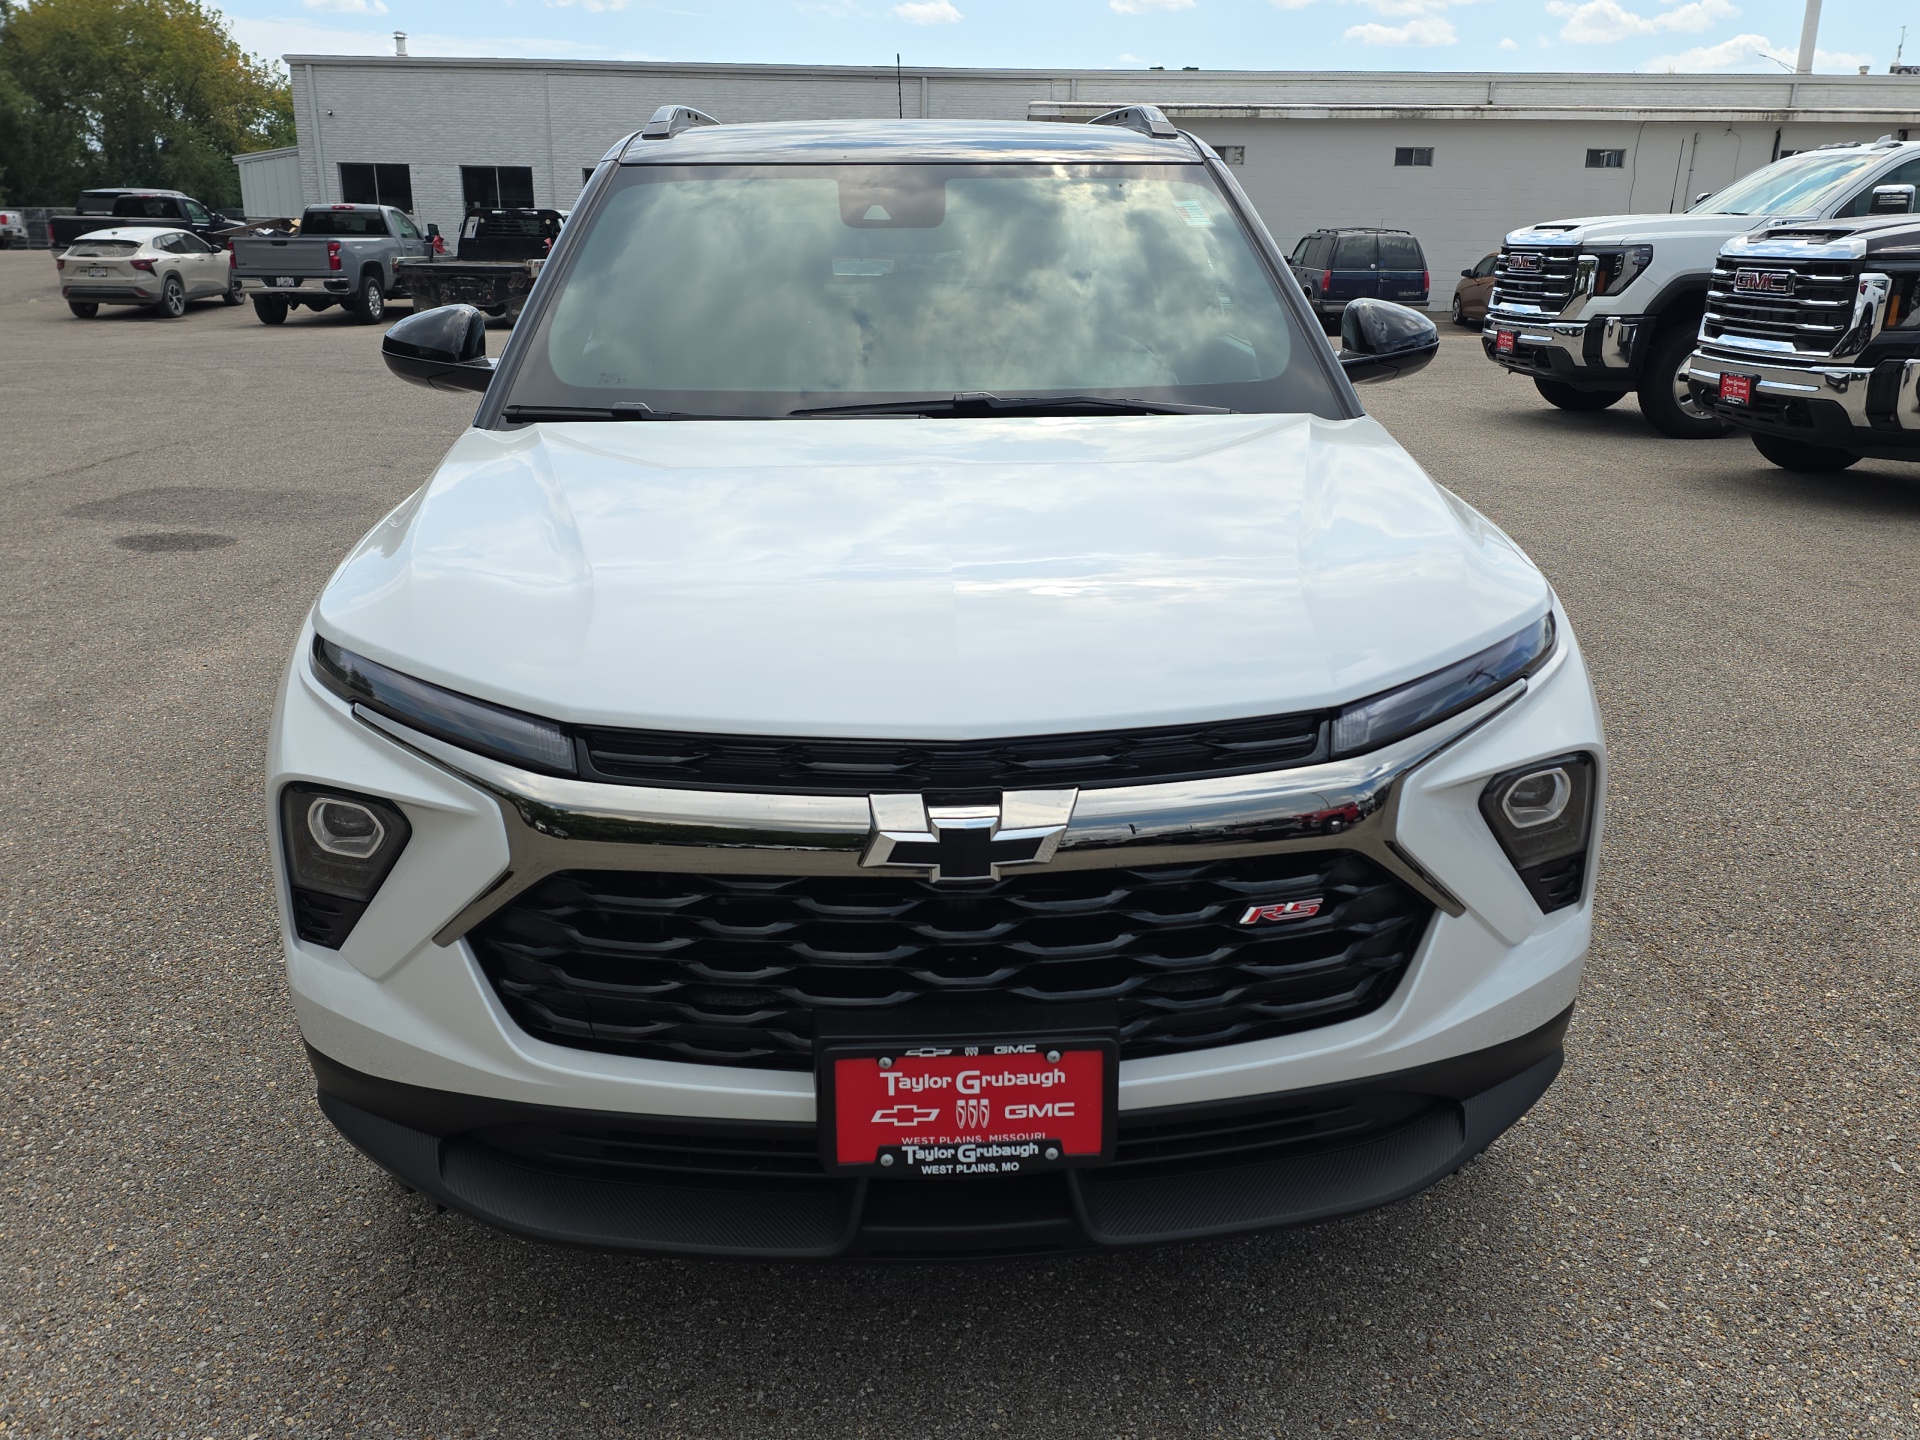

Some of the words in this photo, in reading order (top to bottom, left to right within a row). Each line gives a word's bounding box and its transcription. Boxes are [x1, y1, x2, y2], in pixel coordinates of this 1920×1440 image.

[1509, 256, 1537, 269] GMC
[1736, 272, 1787, 291] GMC
[1239, 898, 1324, 924] RS
[993, 1045, 1036, 1055] GMC
[879, 1072, 952, 1096] Taylor
[955, 1068, 1066, 1095] Grubaugh
[1004, 1102, 1075, 1119] GMC
[902, 1136, 935, 1145] WEST
[989, 1132, 1046, 1142] MISSOURI
[901, 1146, 955, 1165] Taylor
[957, 1143, 1039, 1163] Grubaugh
[921, 1165, 954, 1175] WEST
[956, 1163, 999, 1174] PLAINS,
[1002, 1162, 1020, 1172] MO
